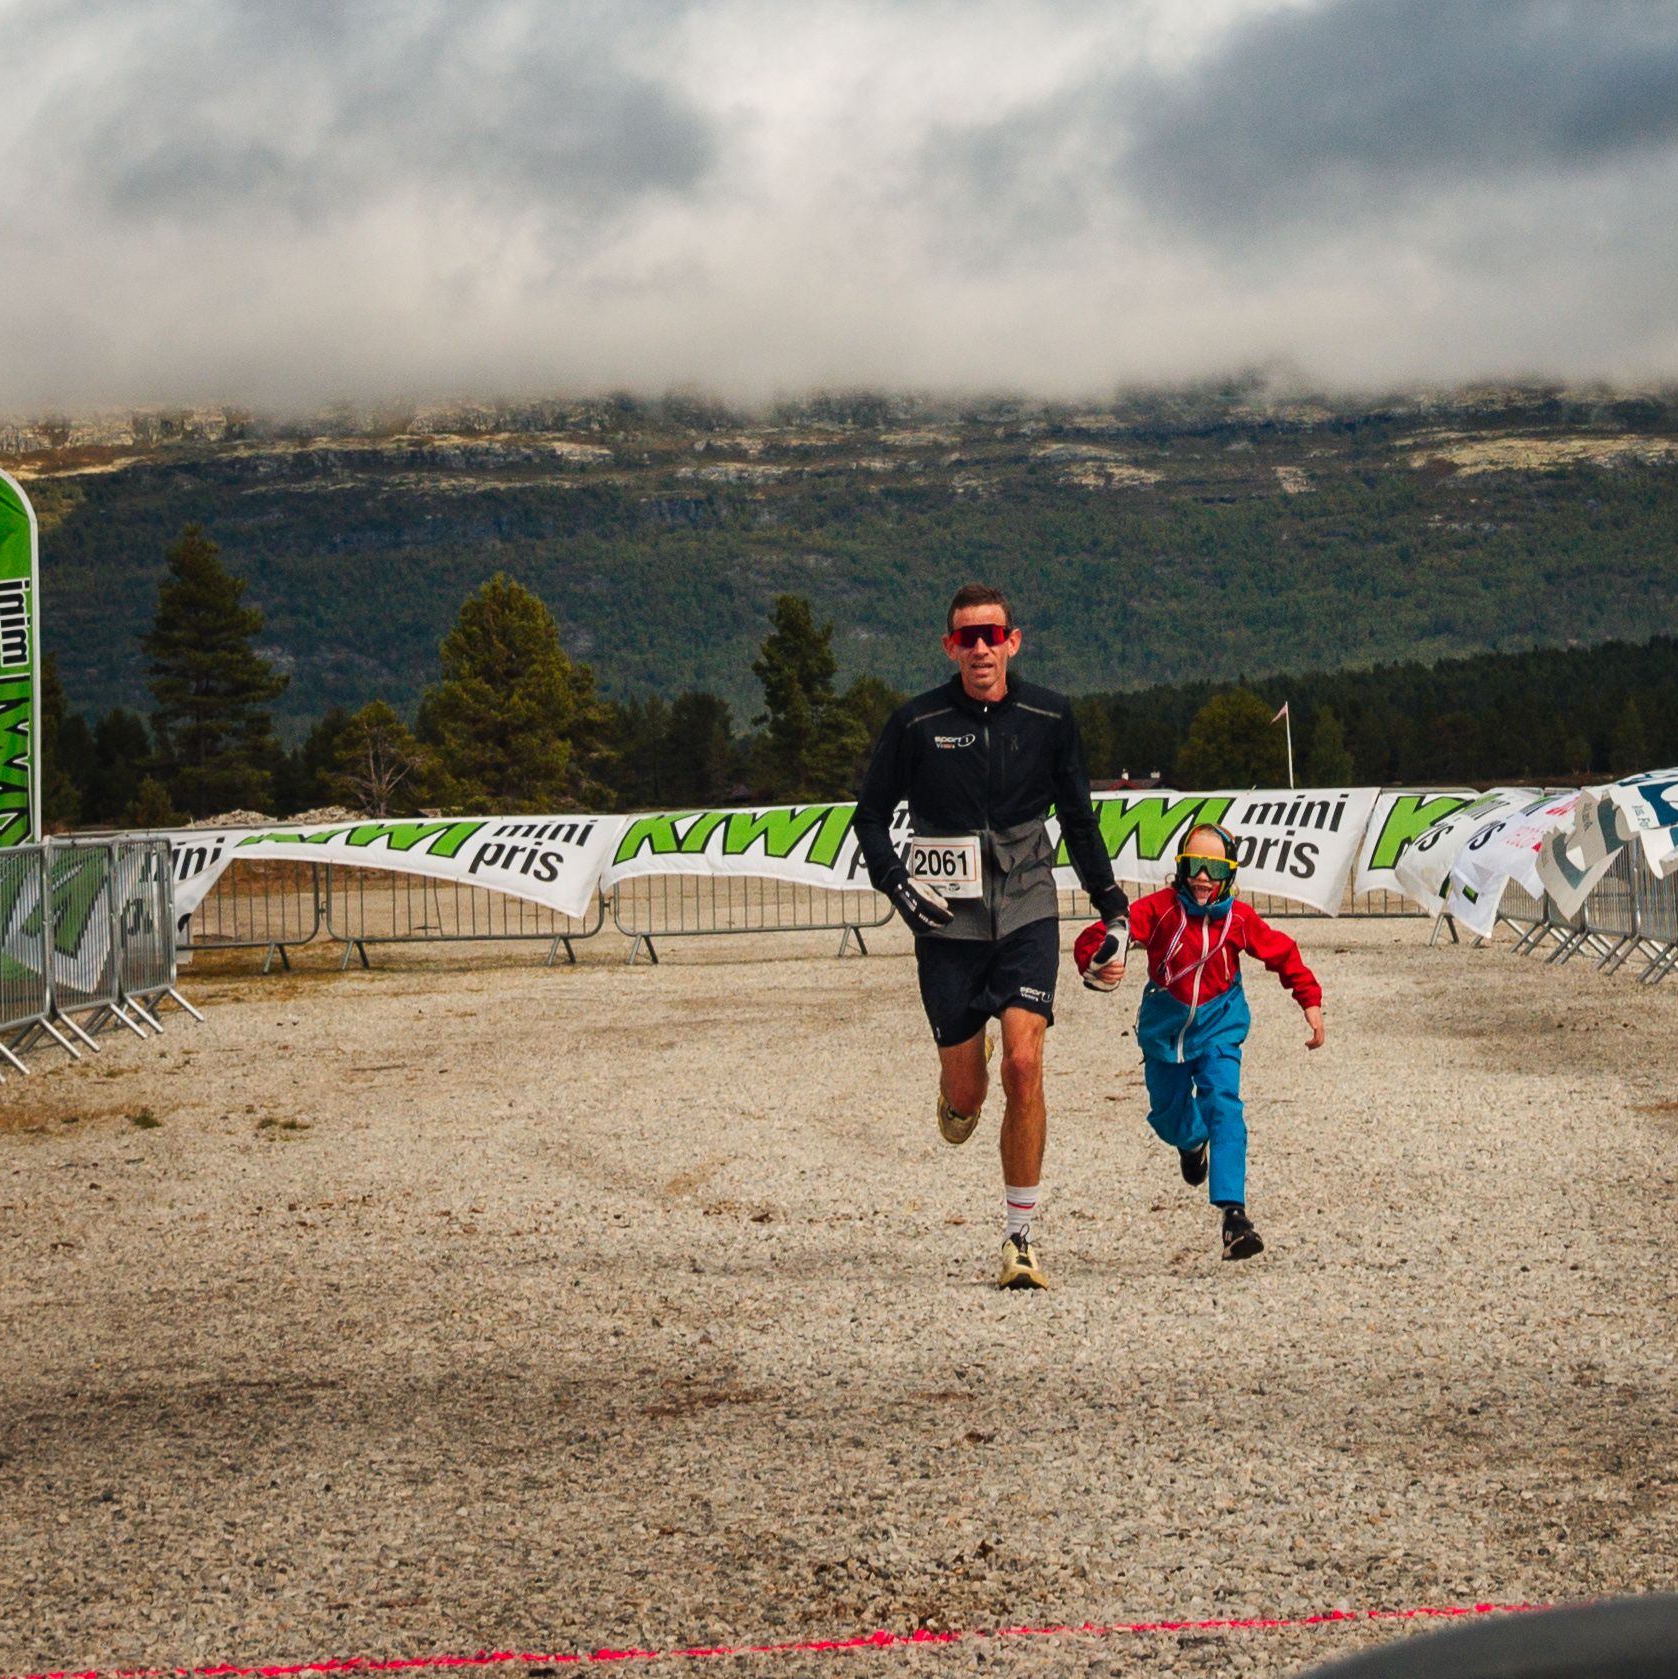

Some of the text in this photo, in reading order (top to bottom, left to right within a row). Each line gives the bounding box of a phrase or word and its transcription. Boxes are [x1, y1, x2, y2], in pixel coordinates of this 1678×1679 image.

[1241, 794, 1350, 832] mini
[492, 819, 599, 847] mini
[612, 805, 860, 871] KIWI
[468, 841, 564, 882] pris
[914, 849, 968, 876] 2061
[1235, 829, 1321, 879] pris
